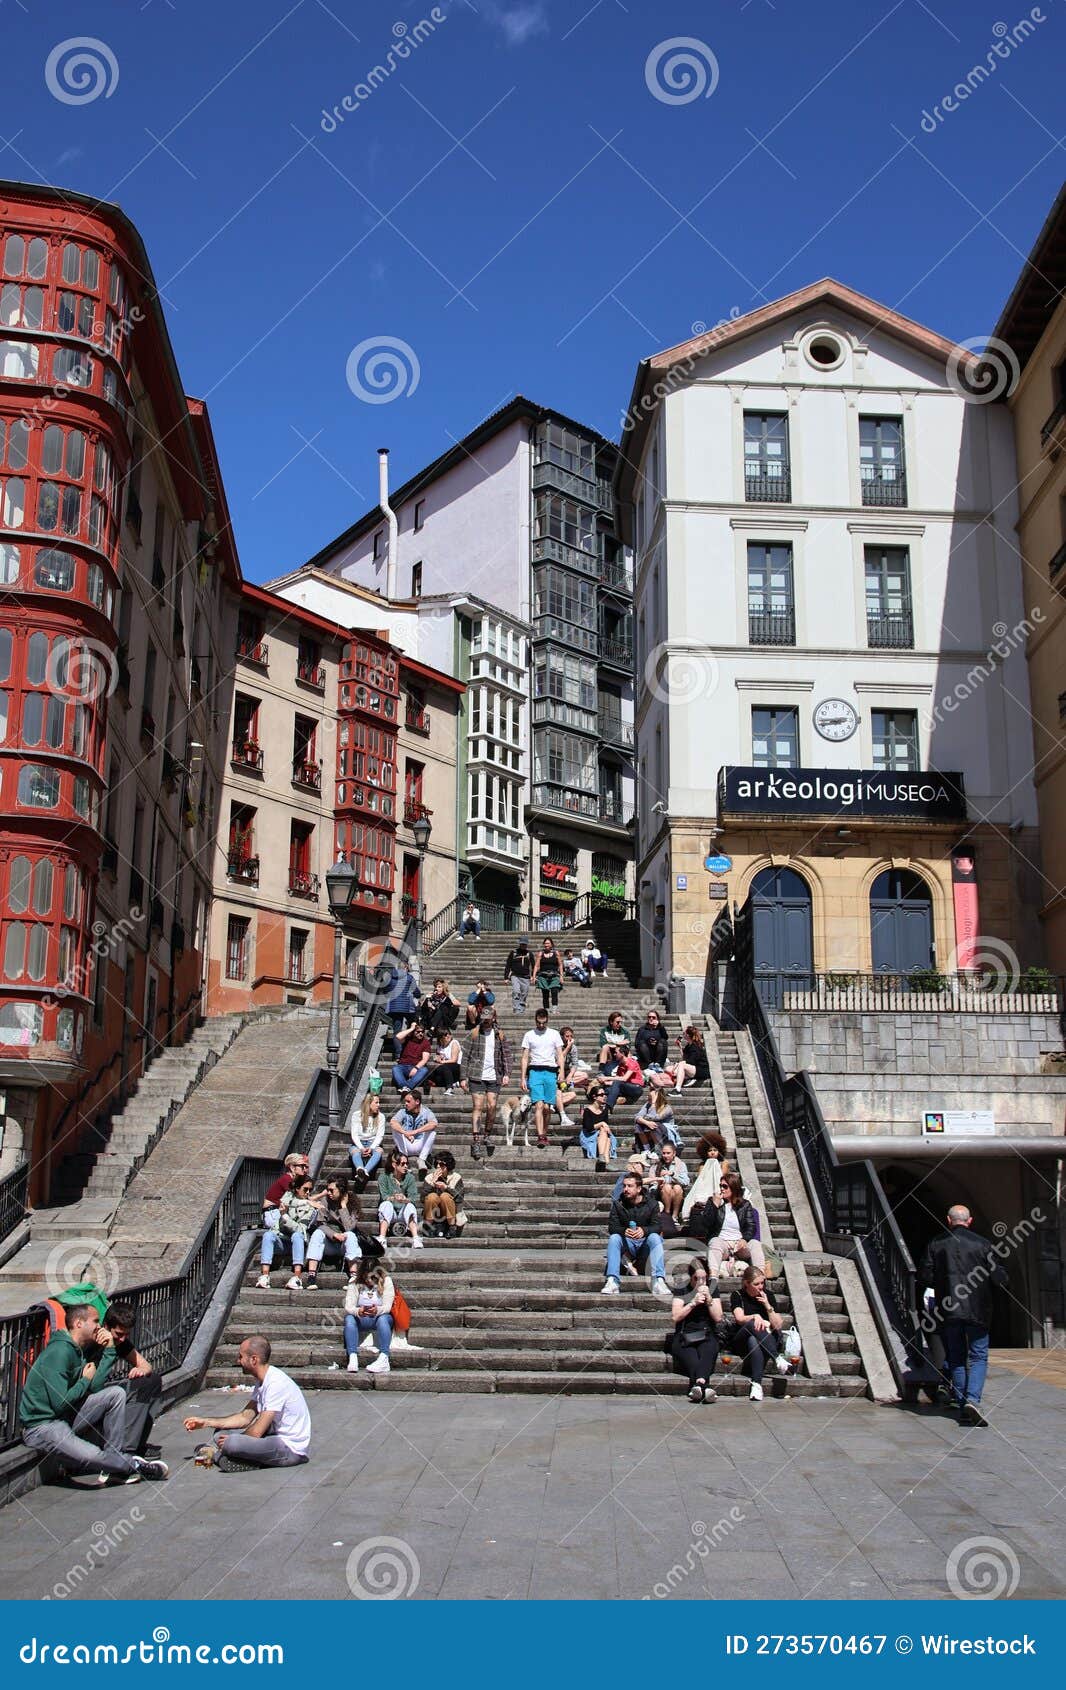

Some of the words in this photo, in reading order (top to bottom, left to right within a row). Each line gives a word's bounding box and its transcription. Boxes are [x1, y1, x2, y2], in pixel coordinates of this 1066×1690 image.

[737, 773, 863, 805] arkeologi
[866, 783, 950, 802] MUSEOA
[542, 862, 570, 881] 97
